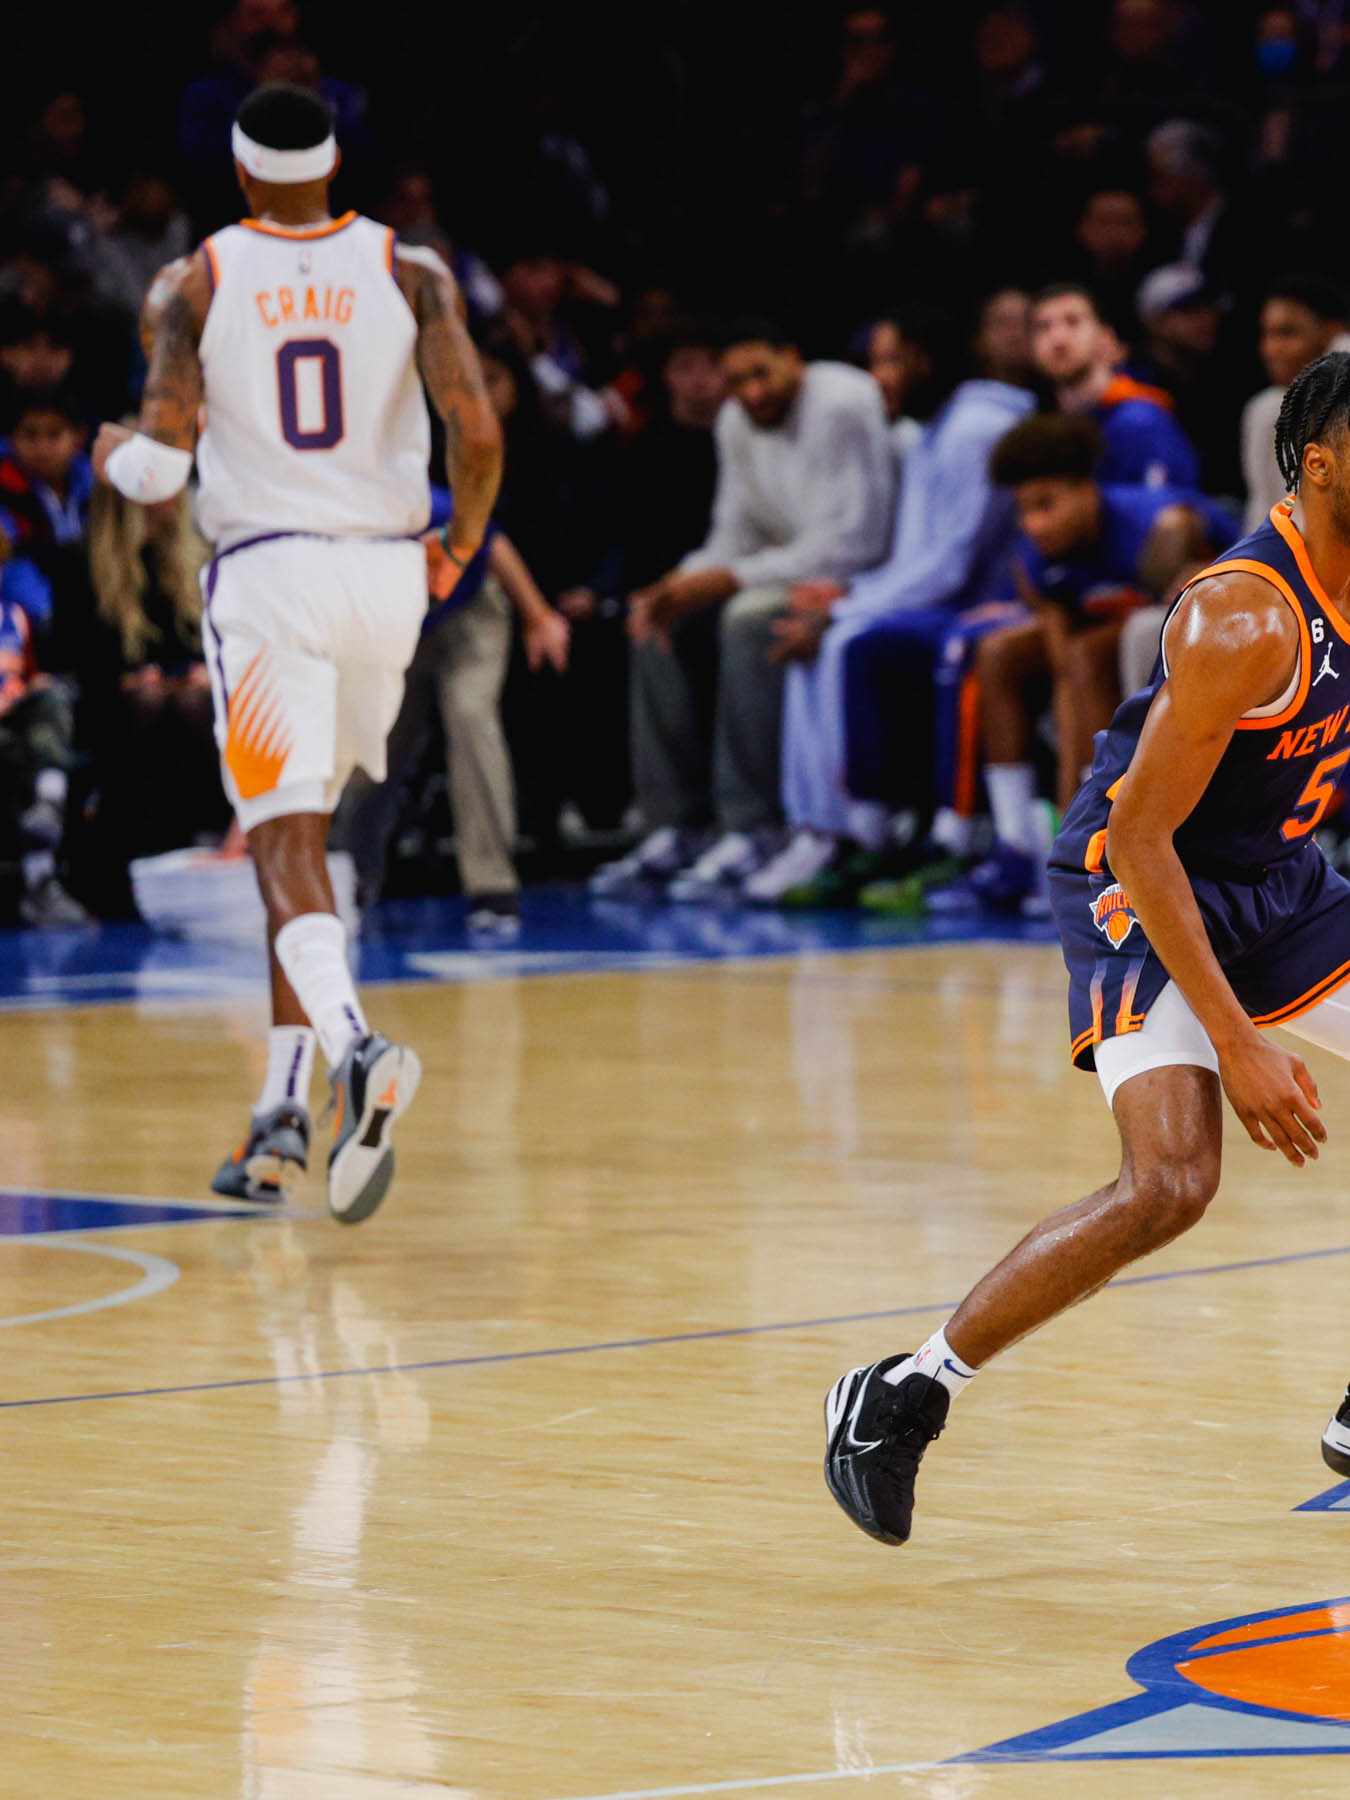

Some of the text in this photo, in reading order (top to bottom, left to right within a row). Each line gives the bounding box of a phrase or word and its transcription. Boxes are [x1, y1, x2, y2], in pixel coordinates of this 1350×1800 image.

[255, 285, 356, 328] CRAIG
[275, 337, 345, 451] 0
[1311, 617, 1325, 644] 6
[1266, 704, 1350, 760] NEW
[1096, 892, 1136, 924] KNICK
